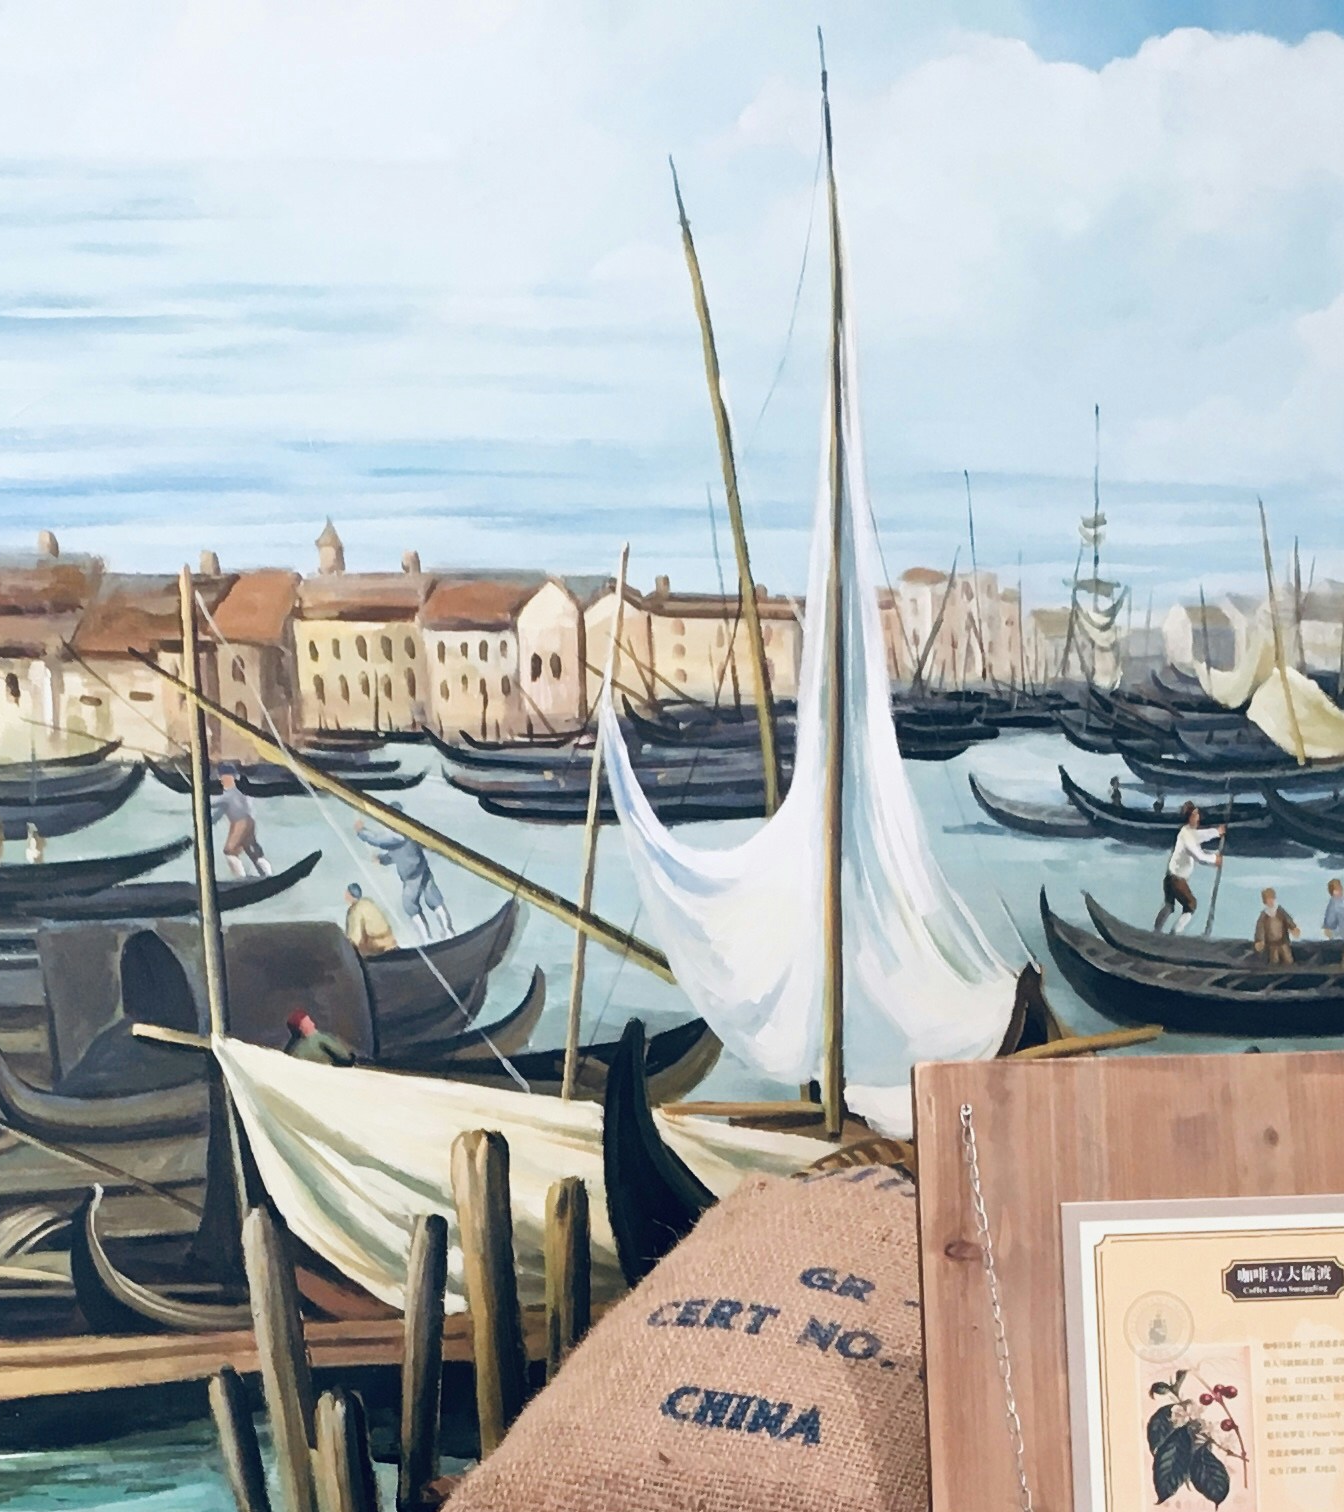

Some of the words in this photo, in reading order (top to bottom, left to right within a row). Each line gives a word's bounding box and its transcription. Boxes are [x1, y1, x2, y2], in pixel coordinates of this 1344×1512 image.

[647, 1298, 780, 1335] CERT
[796, 1314, 896, 1370] NO.
[659, 1386, 821, 1445] CHINA
